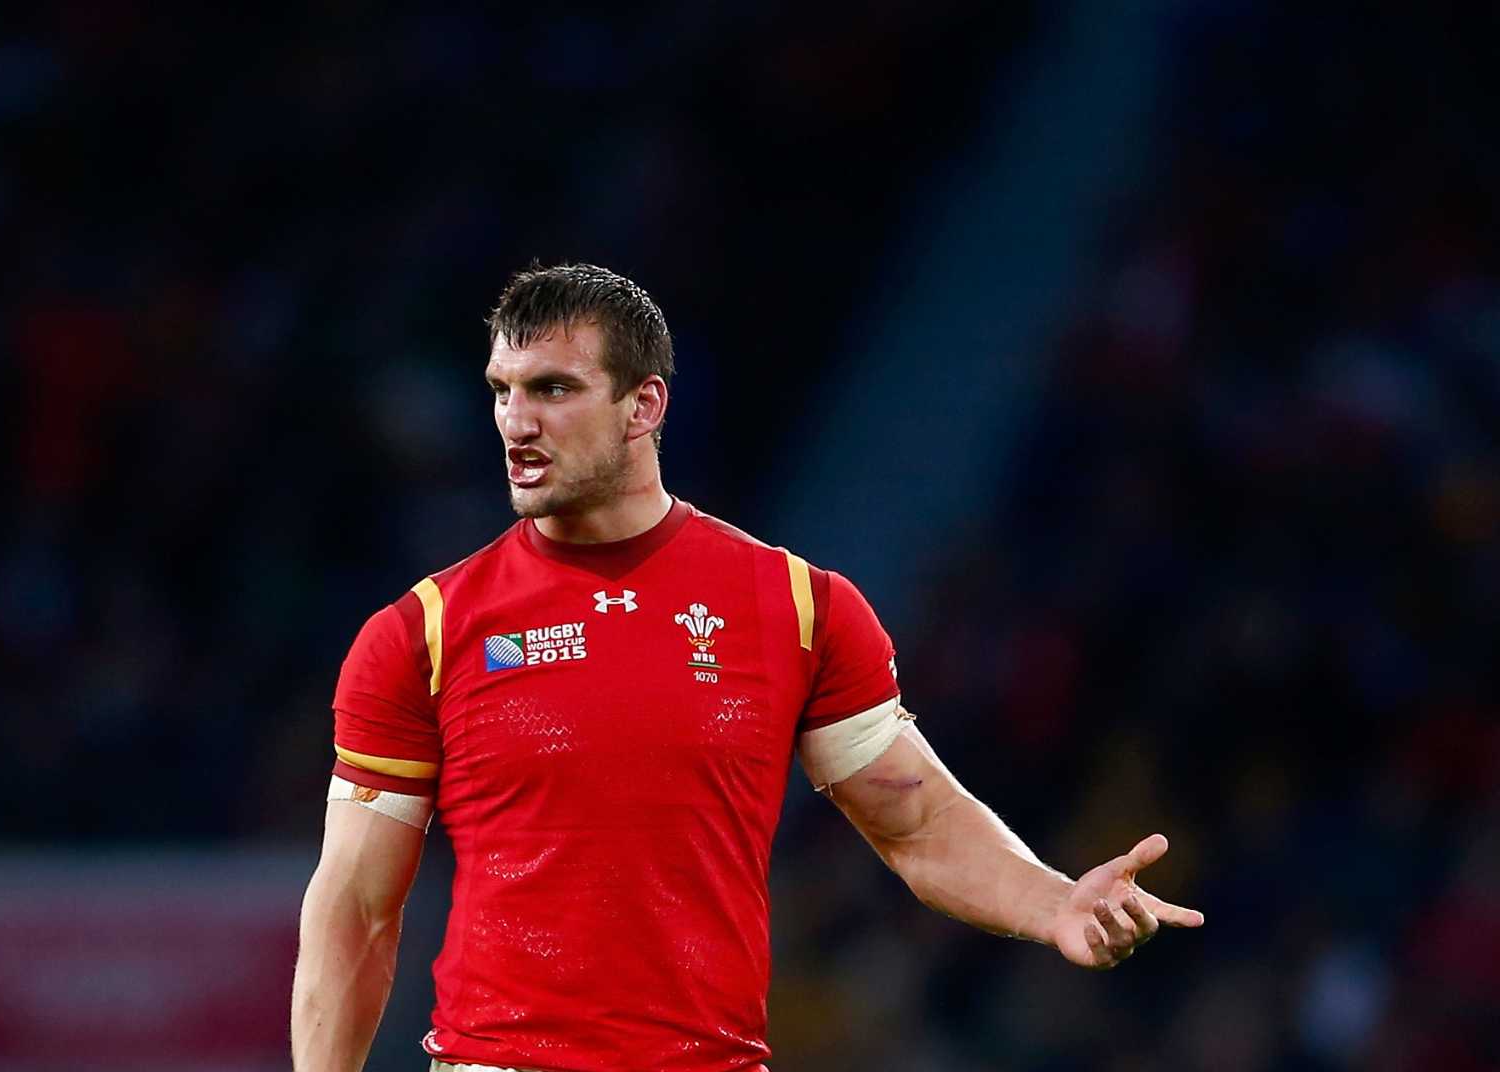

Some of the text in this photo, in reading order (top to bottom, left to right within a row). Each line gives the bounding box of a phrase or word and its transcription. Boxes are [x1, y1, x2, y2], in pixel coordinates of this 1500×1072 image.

[526, 622, 585, 643] RUGBY
[526, 636, 586, 652] WORLD CUP
[526, 645, 587, 666] 2015
[692, 653, 716, 663] WRU
[694, 671, 718, 683] 1070
